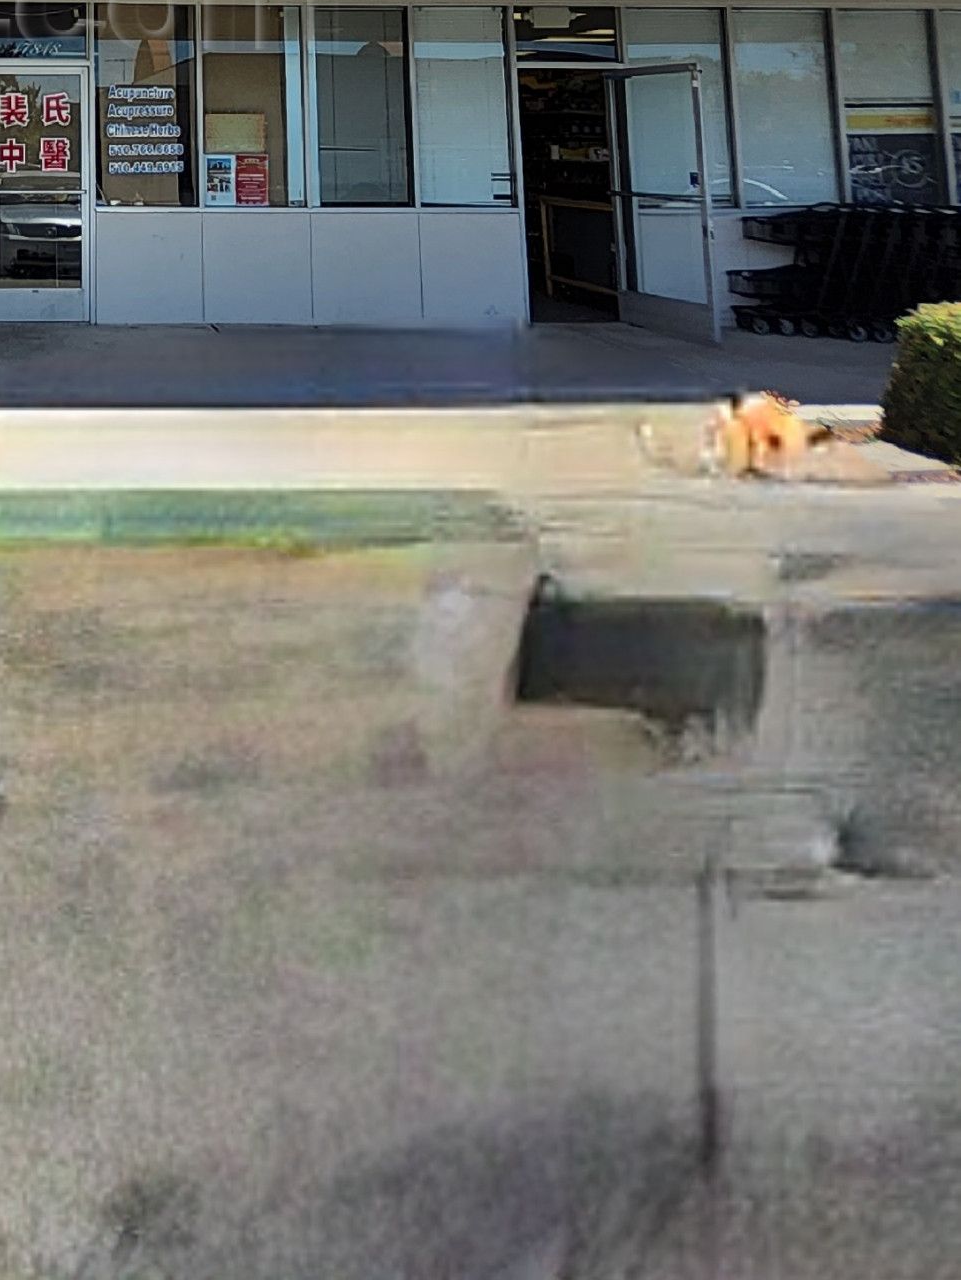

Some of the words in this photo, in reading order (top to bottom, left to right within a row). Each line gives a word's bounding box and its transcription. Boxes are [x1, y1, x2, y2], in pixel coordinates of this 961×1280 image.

[108, 85, 175, 102] Acupuncture
[108, 104, 174, 120] Acupressure
[107, 124, 149, 137] Chinese
[149, 123, 180, 137] Herbs
